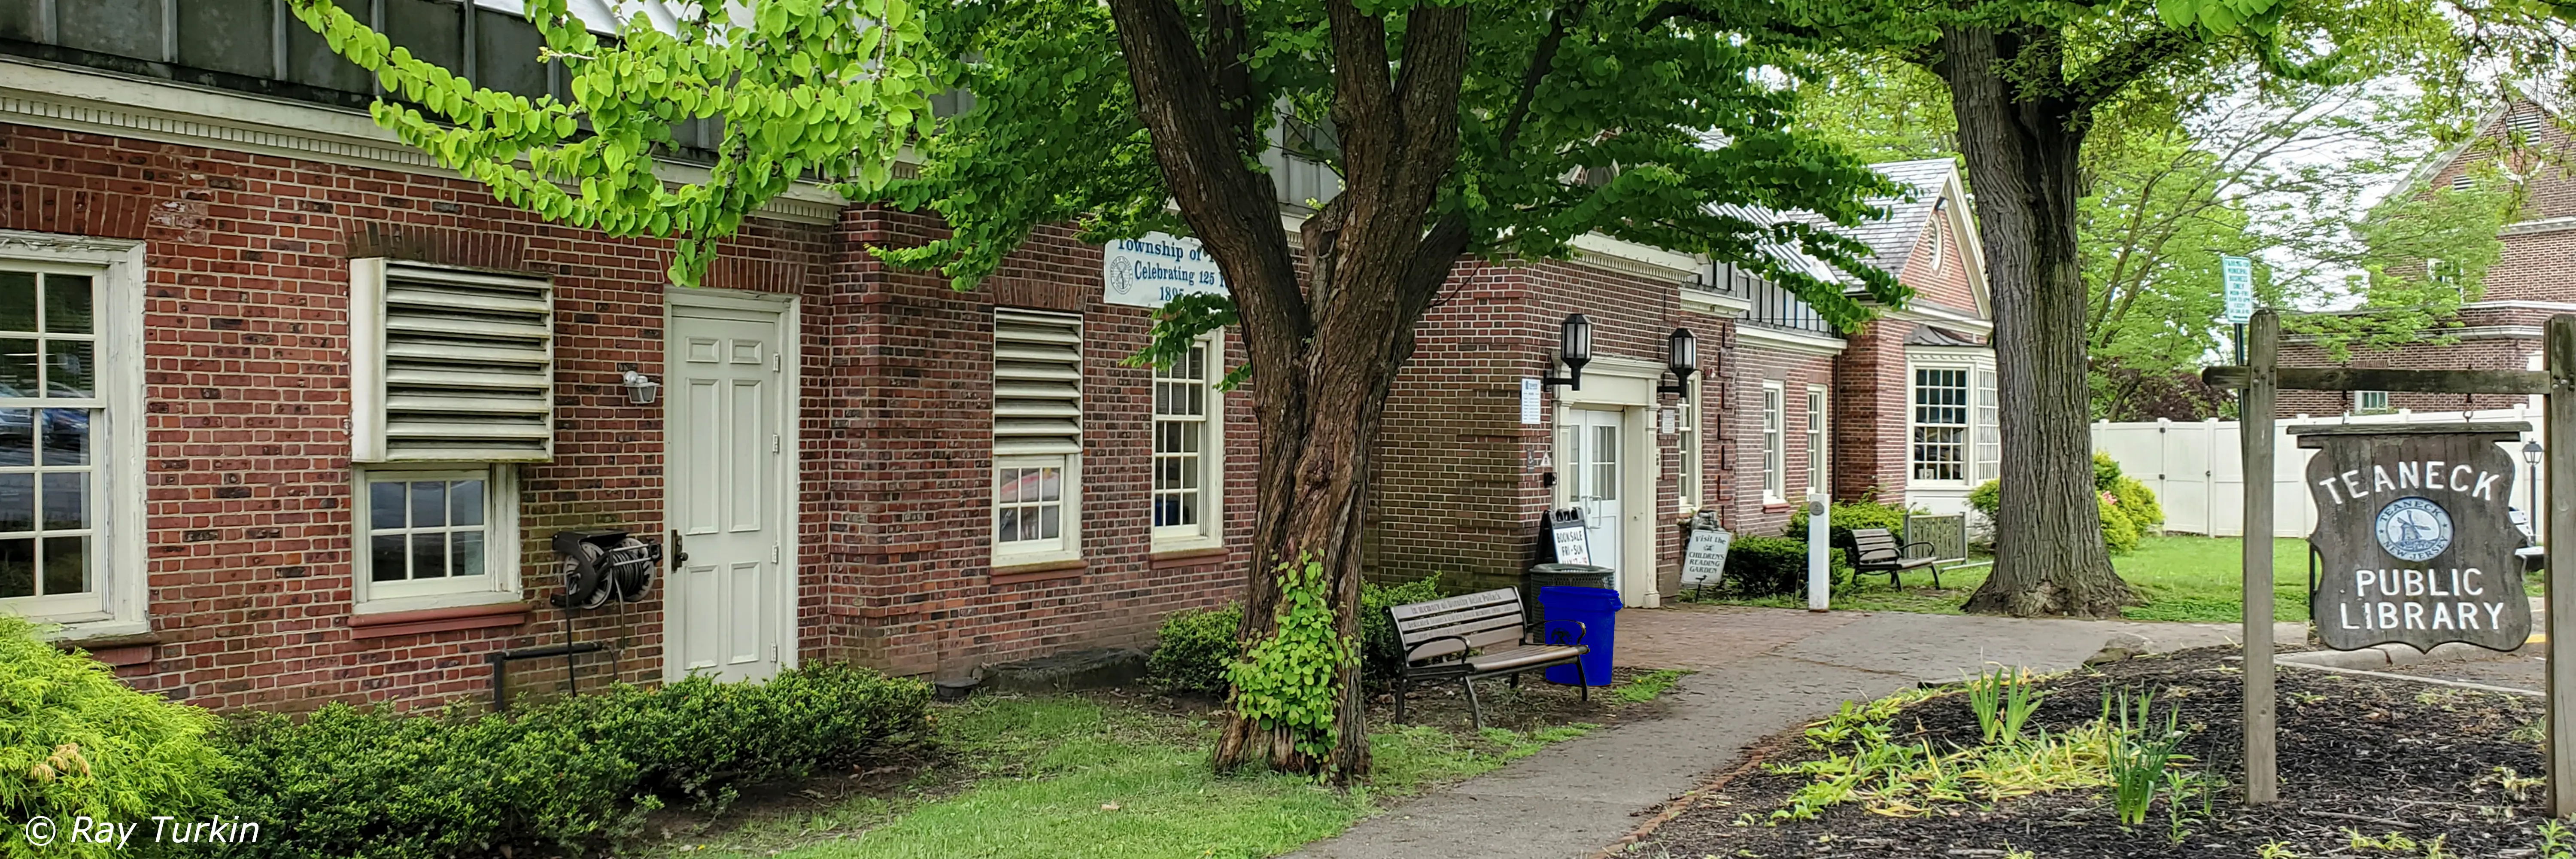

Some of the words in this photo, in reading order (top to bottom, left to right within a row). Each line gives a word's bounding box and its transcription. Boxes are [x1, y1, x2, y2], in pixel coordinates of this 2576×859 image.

[1135, 260, 1195, 286] Celebrating
[1199, 271, 1215, 285] 125
[2319, 460, 2500, 505] TEANECK
[2380, 501, 2442, 522] TEANECK
[1715, 536, 1726, 545] the
[2384, 541, 2407, 557] NEW
[2409, 536, 2448, 560] JERSEY
[2356, 567, 2483, 597] PUBLIC
[2340, 601, 2504, 631] LIBRARY
